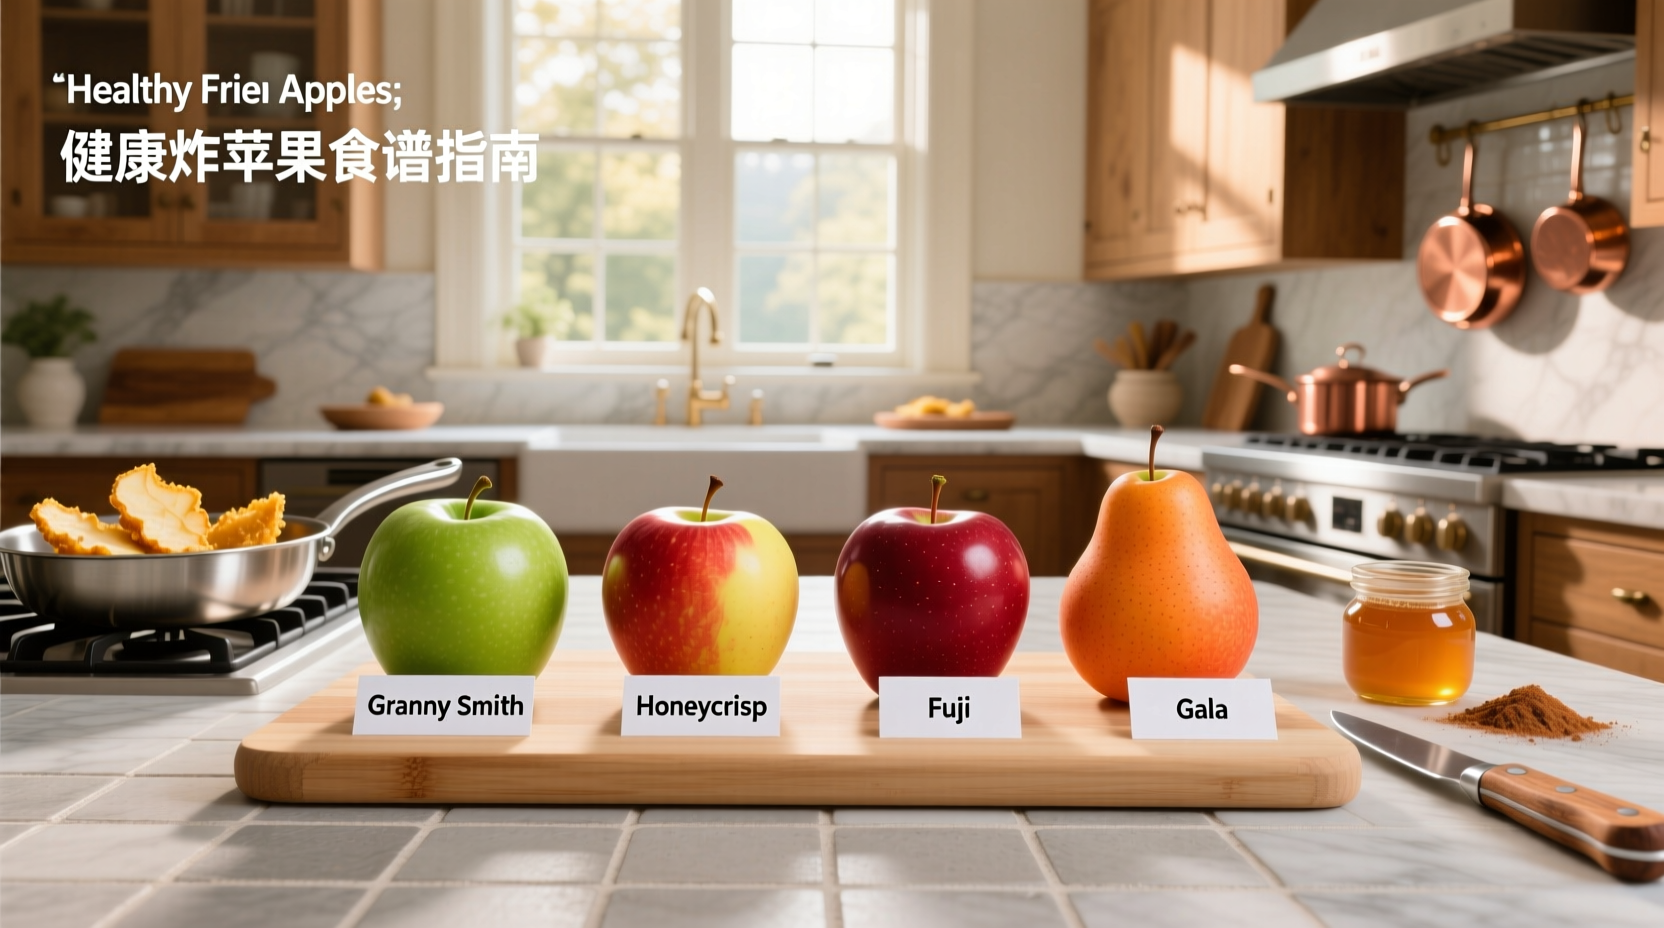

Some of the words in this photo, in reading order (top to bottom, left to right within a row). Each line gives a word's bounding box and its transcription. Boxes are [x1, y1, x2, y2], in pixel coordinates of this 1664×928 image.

[367, 694, 451, 721] Granny
[457, 693, 525, 716] Smith
[636, 694, 768, 722] Honeycrisp
[928, 695, 970, 725] Fuji
[1176, 697, 1229, 720] Gala
